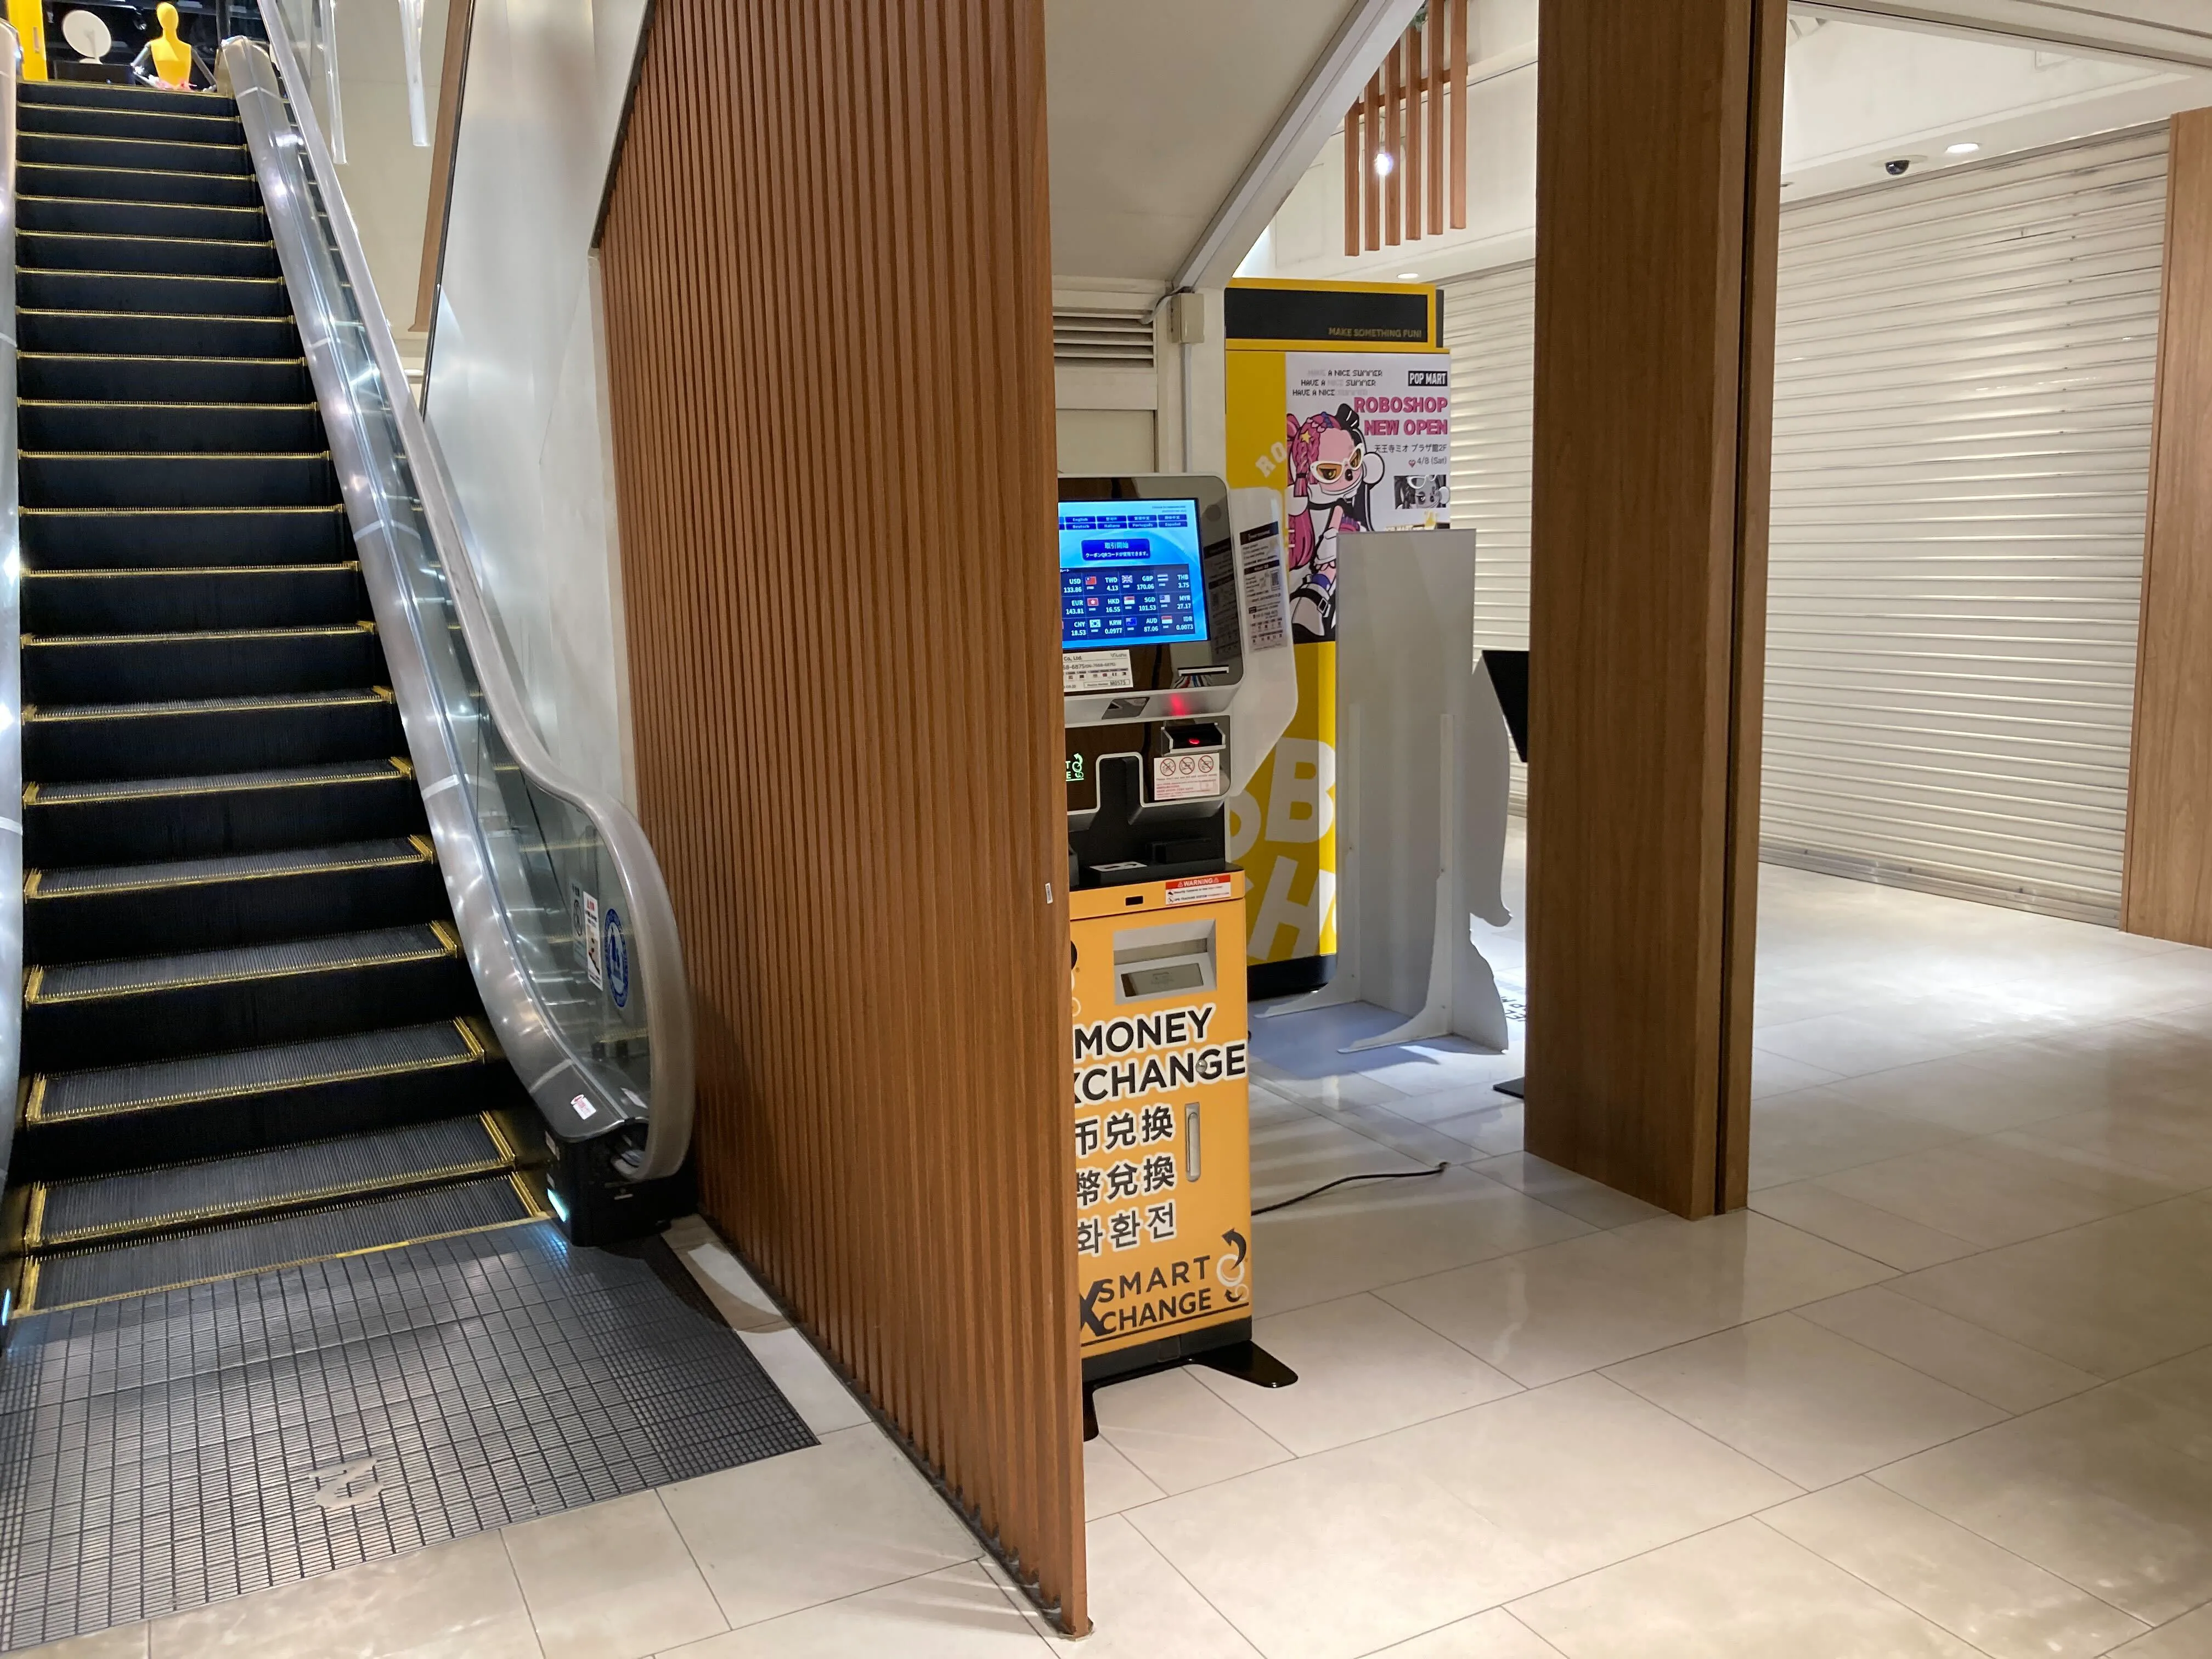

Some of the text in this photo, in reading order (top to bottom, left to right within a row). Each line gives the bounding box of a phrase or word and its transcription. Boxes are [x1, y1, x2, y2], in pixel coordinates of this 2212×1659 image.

[1328, 328, 1422, 338] MAKE SOMETHING FUN!
[1409, 373, 1446, 385] POP MART
[1354, 397, 1448, 413] ROBOSHOP
[1364, 419, 1448, 436] NEW OPEN
[1431, 456, 1447, 465] (Sat)
[1183, 878, 1213, 887] WARNING
[1075, 1007, 1212, 1059] MONEY
[1077, 1202, 1175, 1254] 화환전
[1097, 1255, 1210, 1303] SMART
